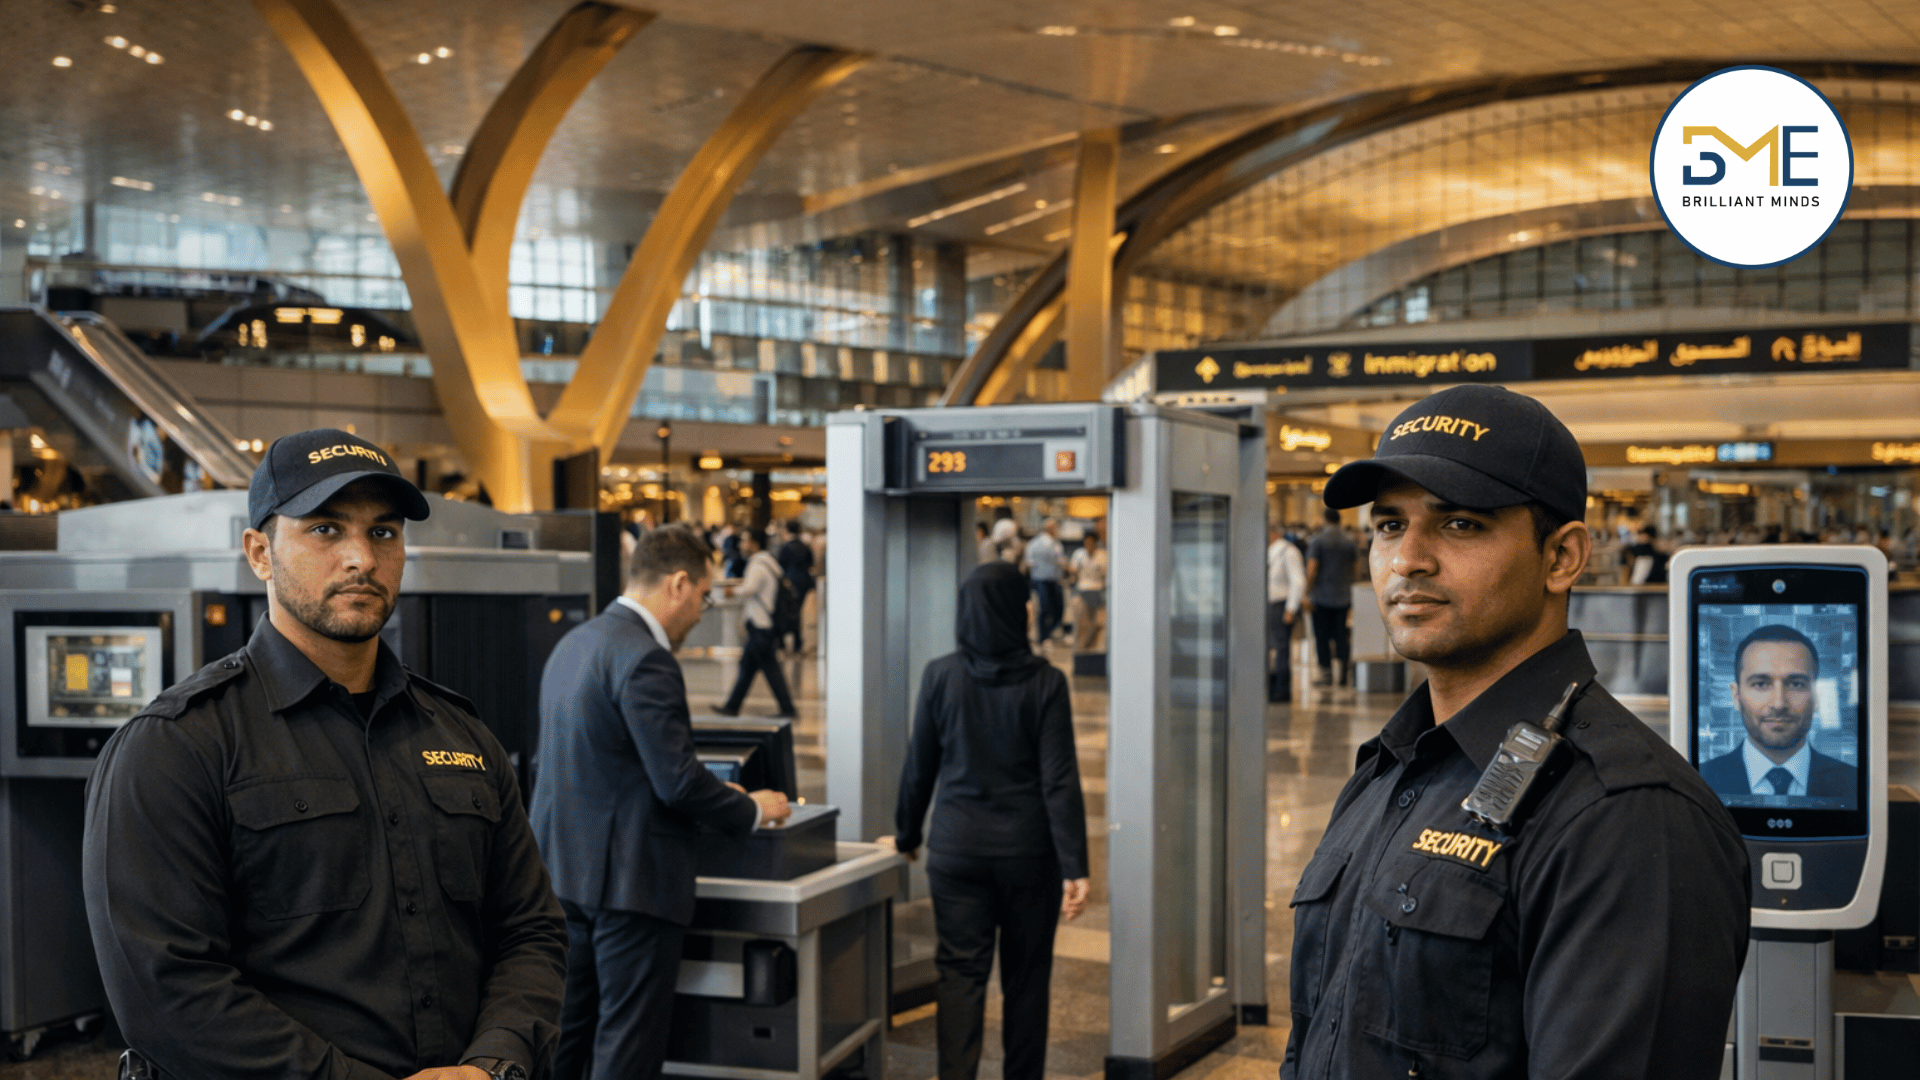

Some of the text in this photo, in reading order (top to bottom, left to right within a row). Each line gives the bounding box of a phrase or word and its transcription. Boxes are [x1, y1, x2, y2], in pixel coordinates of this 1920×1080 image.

[1390, 415, 1491, 442] SECURITY
[421, 750, 487, 771] SECURITY
[1412, 827, 1502, 867] SECURITY
